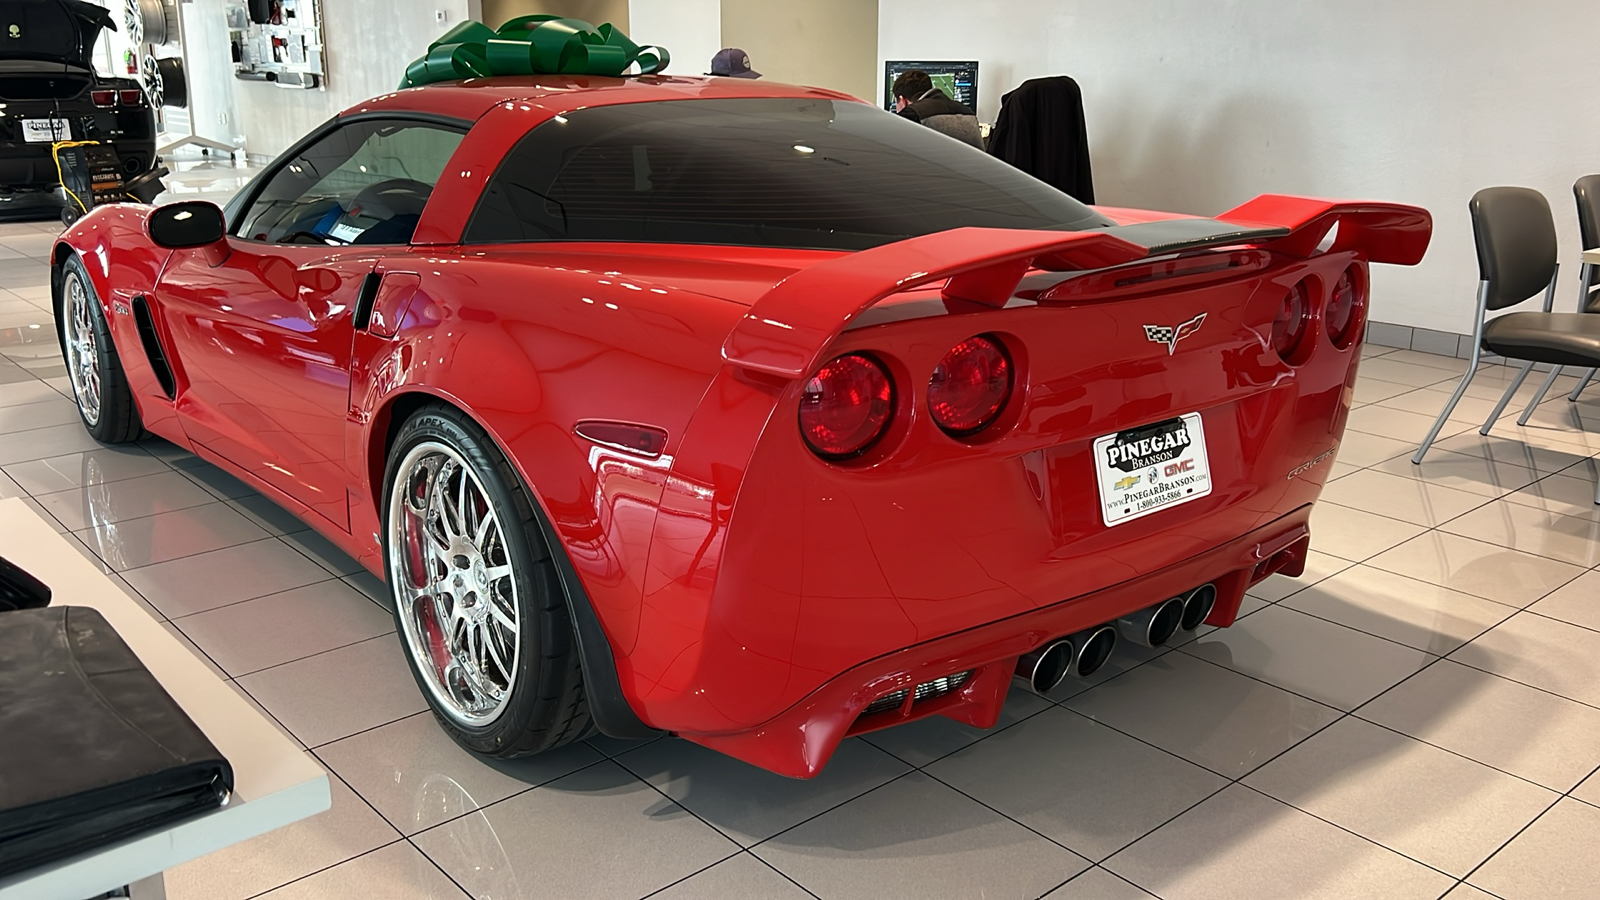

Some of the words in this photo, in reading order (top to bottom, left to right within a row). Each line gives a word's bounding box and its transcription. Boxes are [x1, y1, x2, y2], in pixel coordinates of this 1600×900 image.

[418, 417, 445, 431] APEX
[1107, 427, 1190, 466] PINEGAR
[1131, 449, 1174, 470] BRANSON
[1163, 457, 1195, 478] GMC
[1286, 445, 1337, 480] CORVETTE
[1136, 489, 1182, 512] 1-800-933-5866
